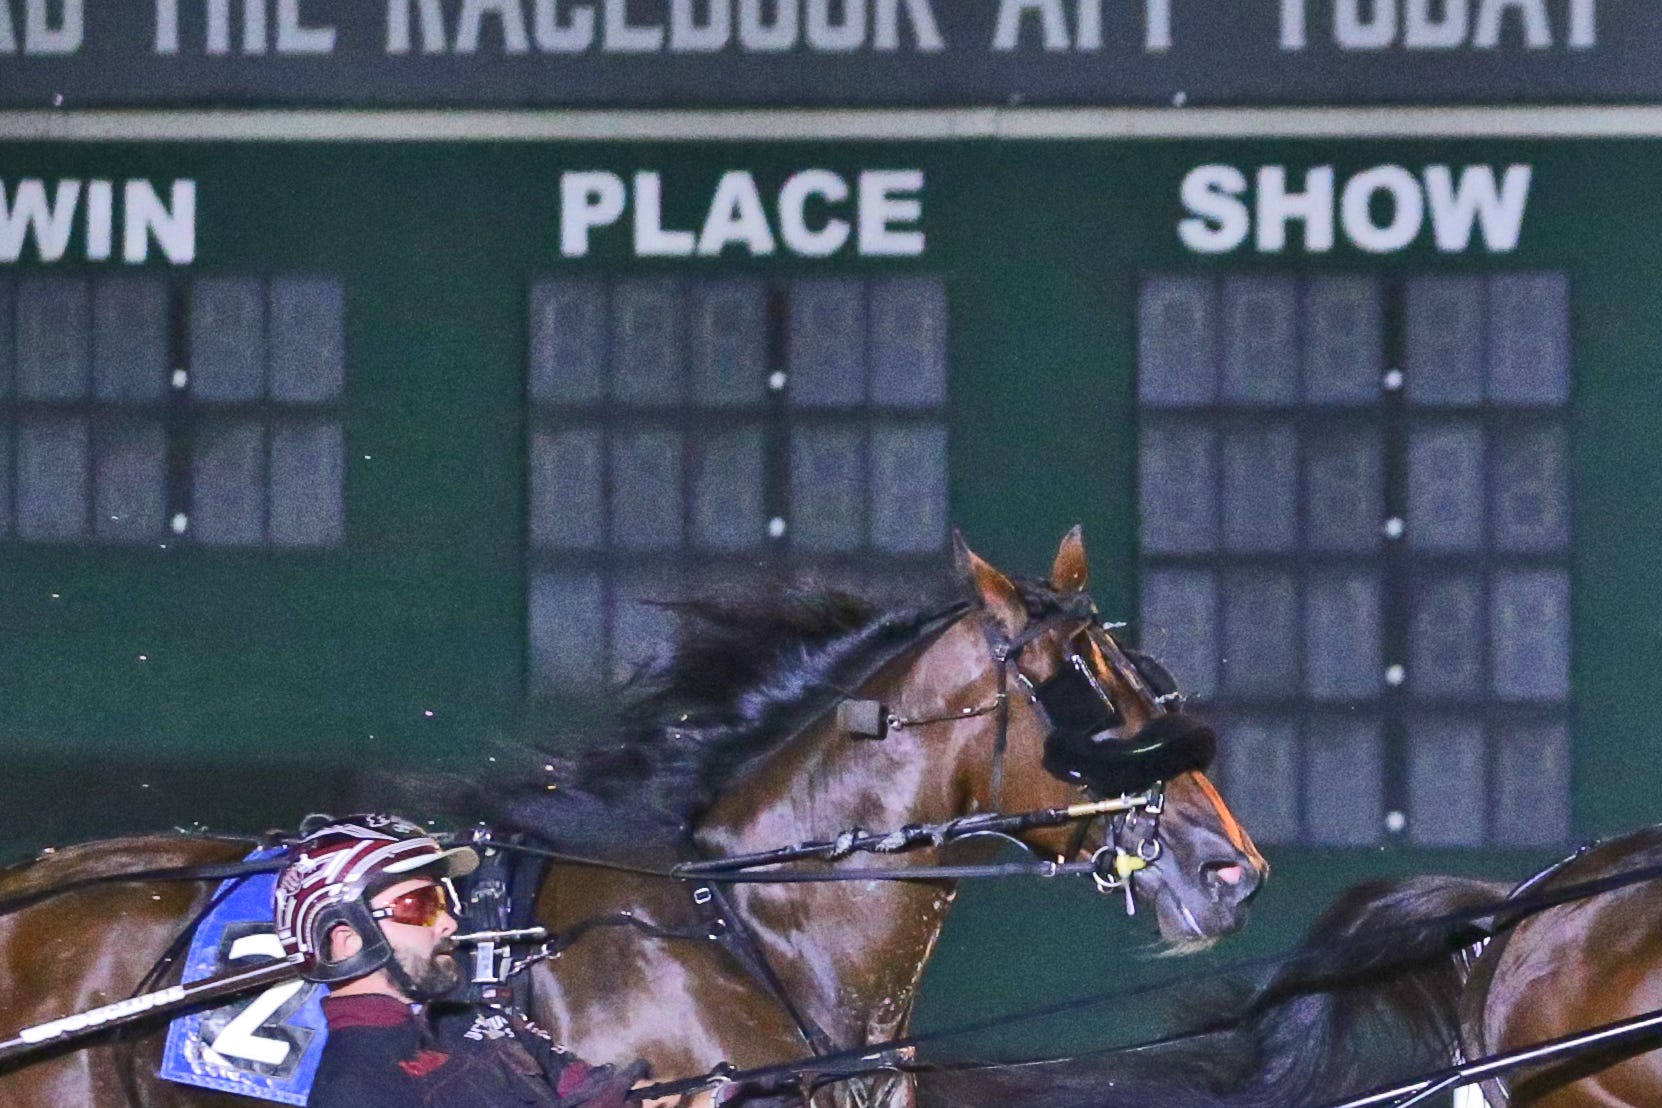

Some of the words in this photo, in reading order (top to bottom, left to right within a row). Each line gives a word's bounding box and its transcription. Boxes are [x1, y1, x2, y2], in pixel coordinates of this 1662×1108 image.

[0, 179, 197, 264] WIN
[559, 168, 927, 258] PLACE
[1176, 163, 1534, 254] SHOW
[211, 933, 304, 1066] 2
